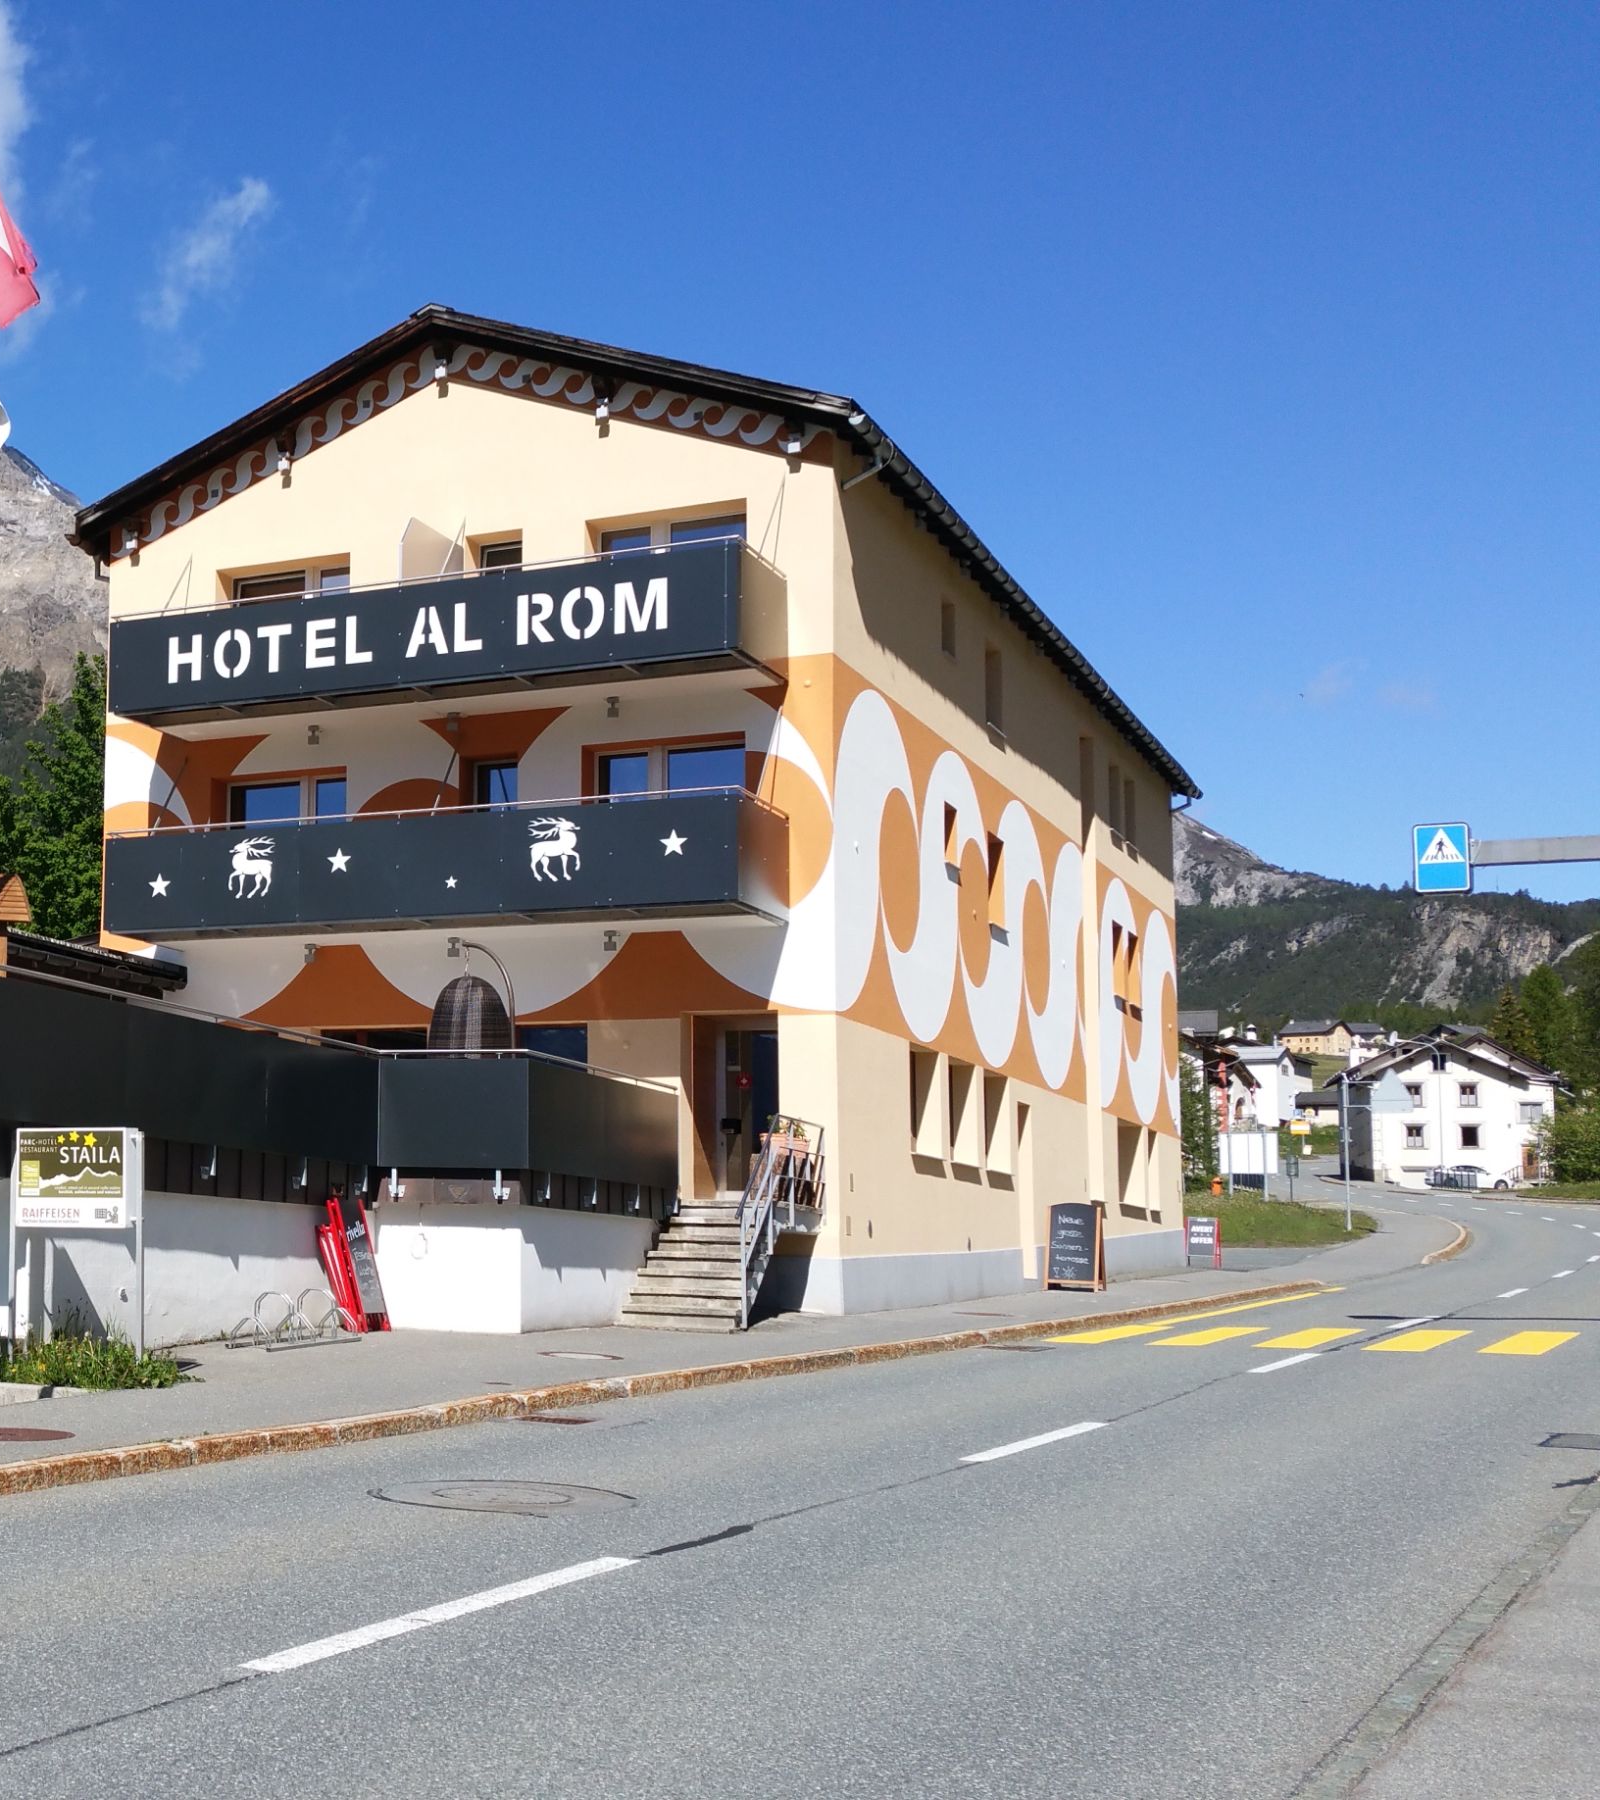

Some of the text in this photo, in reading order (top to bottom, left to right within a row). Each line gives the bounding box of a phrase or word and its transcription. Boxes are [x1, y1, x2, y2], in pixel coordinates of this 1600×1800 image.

[167, 576, 670, 685] HOTEL AL ROM
[59, 1146, 121, 1164] STAILA
[21, 1207, 81, 1218] RAIFFEISEN
[1058, 1214, 1084, 1225] Neue
[346, 1220, 366, 1241] rivella
